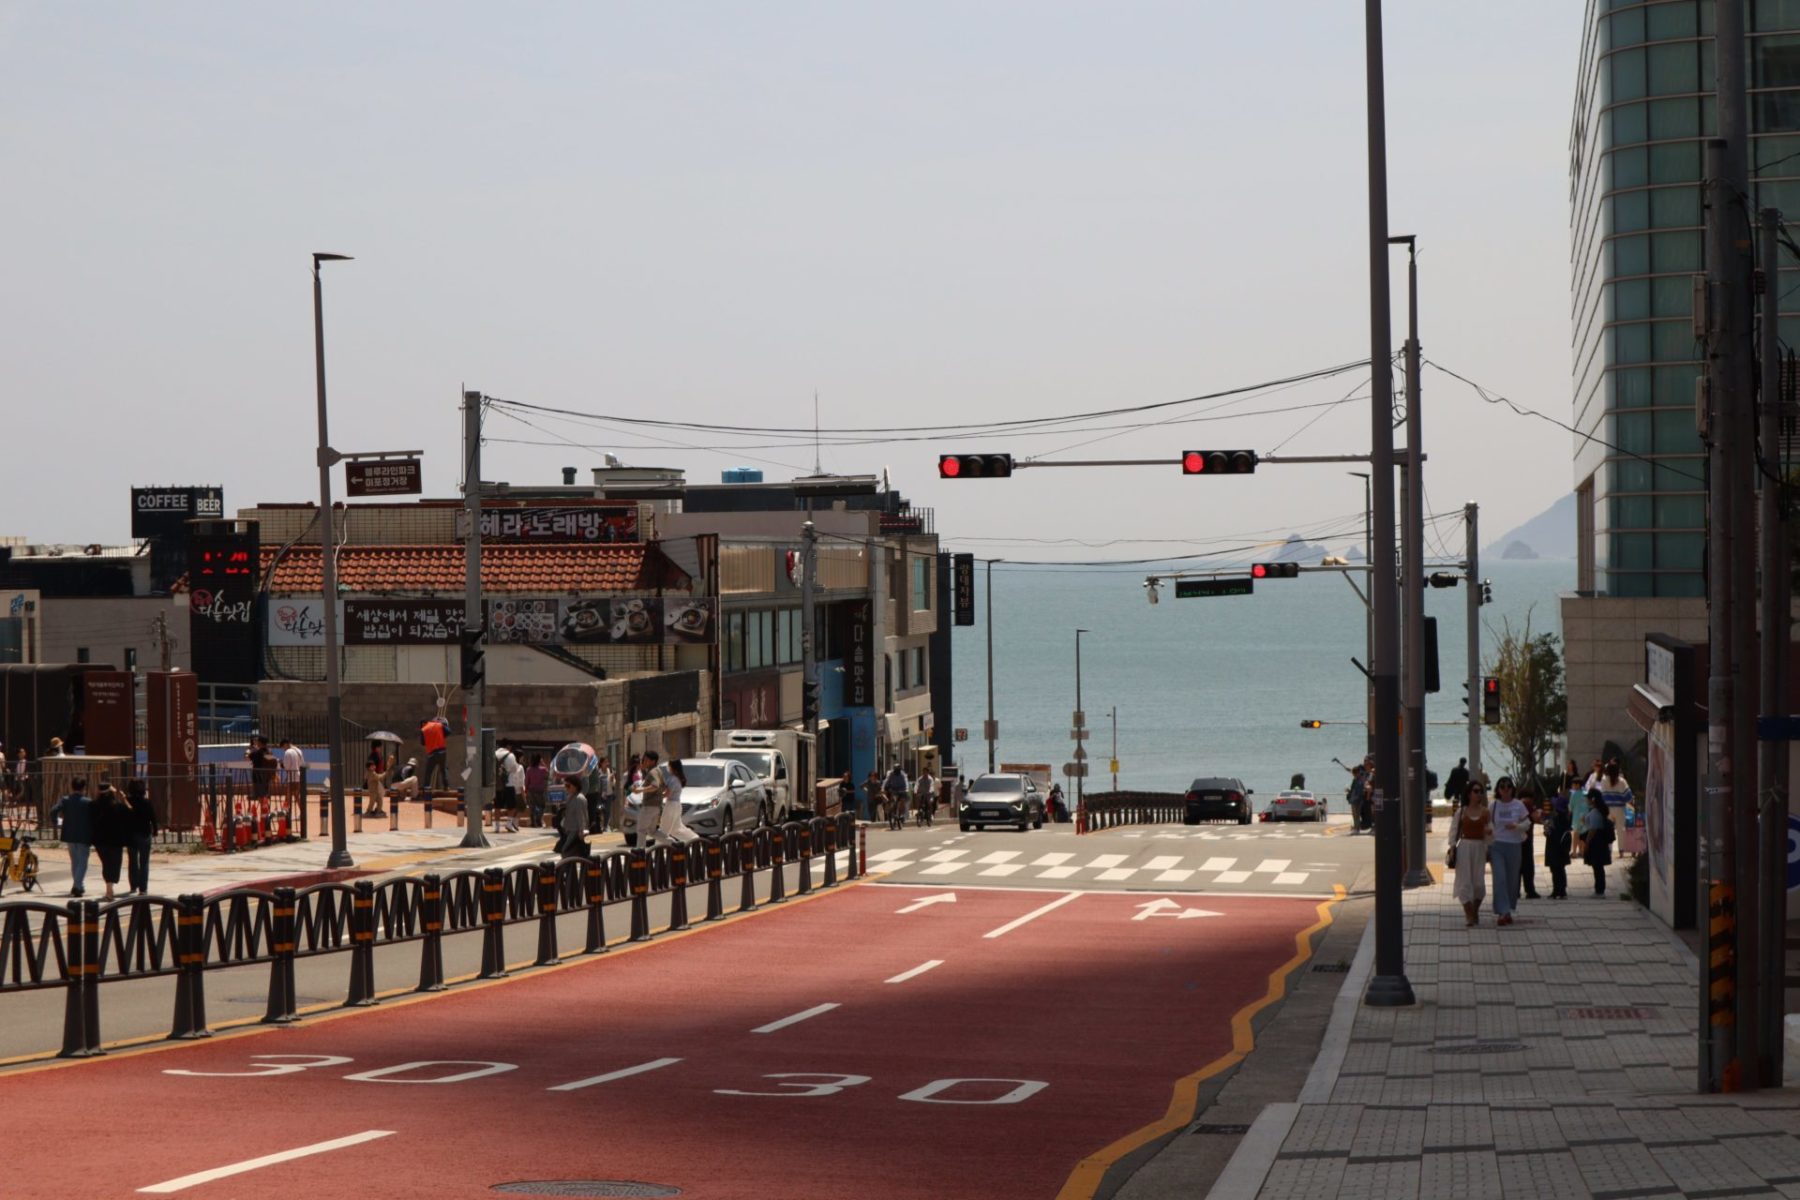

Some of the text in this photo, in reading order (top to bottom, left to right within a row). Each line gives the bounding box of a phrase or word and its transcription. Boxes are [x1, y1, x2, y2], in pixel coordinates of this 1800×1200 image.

[137, 494, 189, 508] COFFEE
[196, 498, 221, 512] BEER
[413, 608, 440, 624] 제일
[363, 624, 403, 639] 밥집이
[161, 1052, 519, 1084] 30
[712, 1071, 1050, 1105] 30
